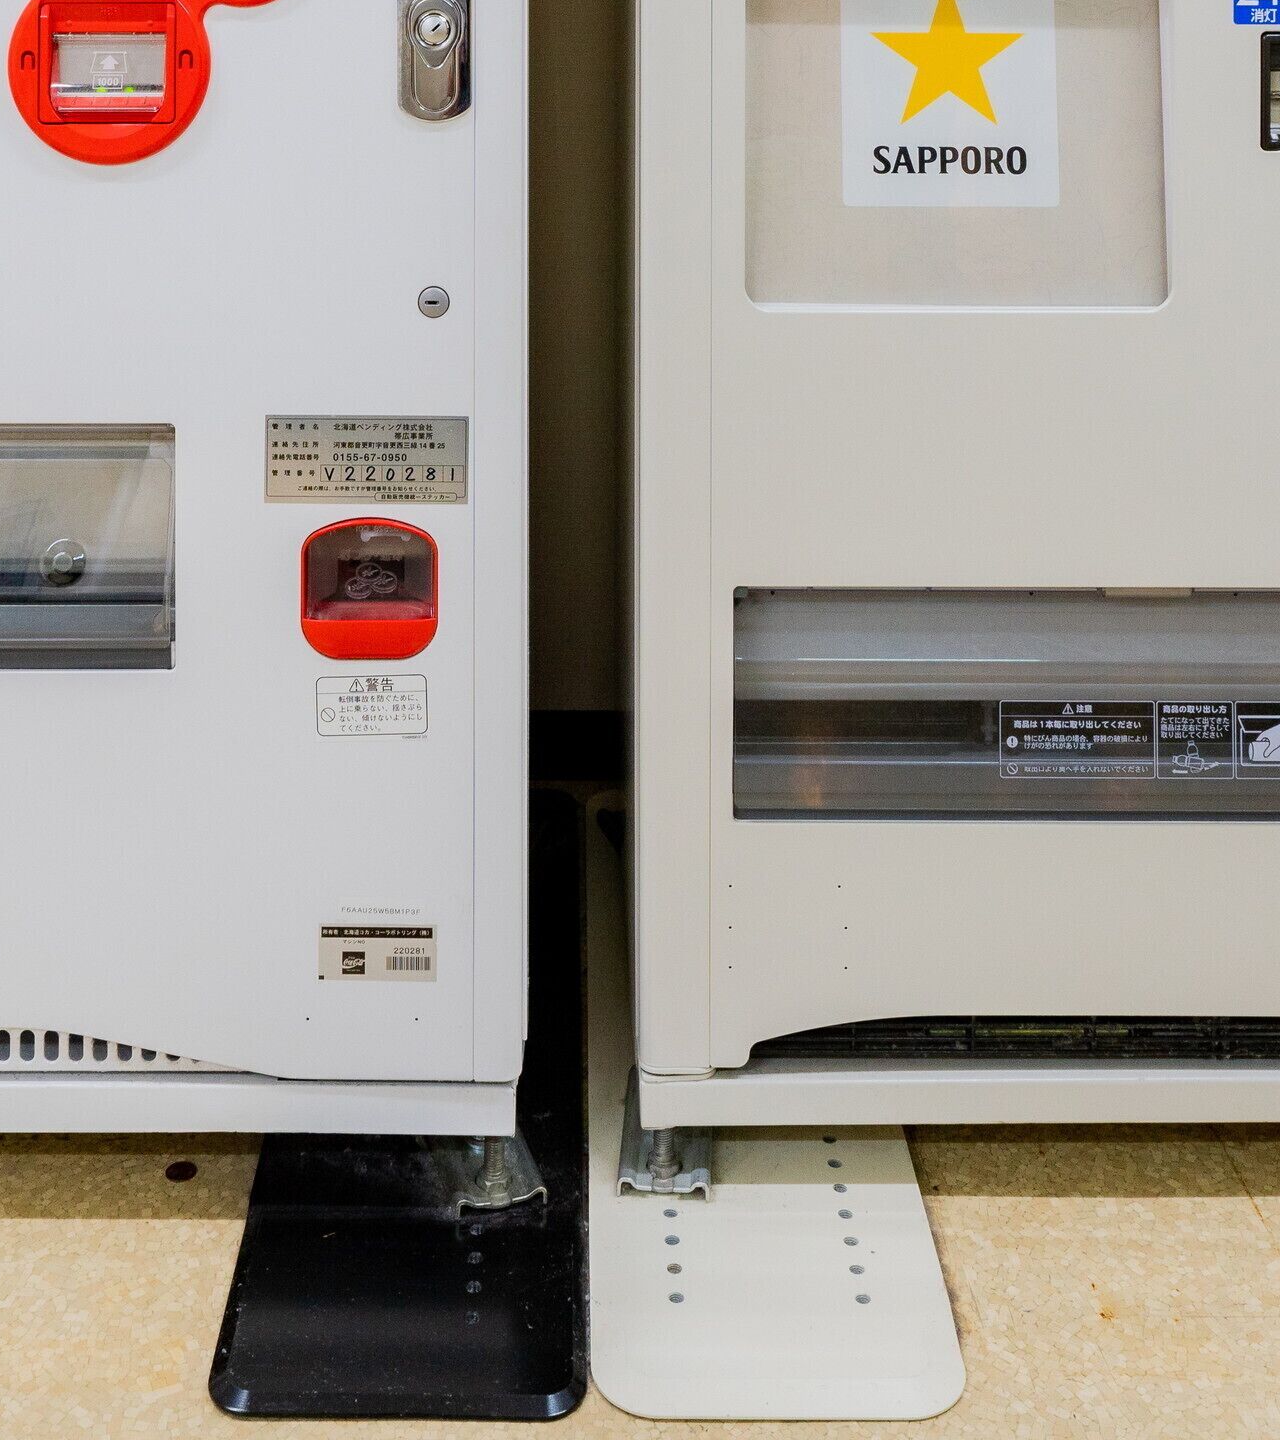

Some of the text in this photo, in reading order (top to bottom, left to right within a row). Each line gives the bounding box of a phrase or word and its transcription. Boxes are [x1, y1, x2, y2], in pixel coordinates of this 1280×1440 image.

[1249, 8, 1277, 22] 消灯
[95, 76, 120, 86] 1000
[873, 145, 1027, 175] SAPPORO
[333, 423, 433, 432] 北海道ベンディング株式会社
[333, 454, 407, 462] 0155-67-0950
[366, 678, 394, 692] 警告
[1076, 705, 1093, 713] 注意
[1163, 705, 1227, 714] 商品の取り出し方
